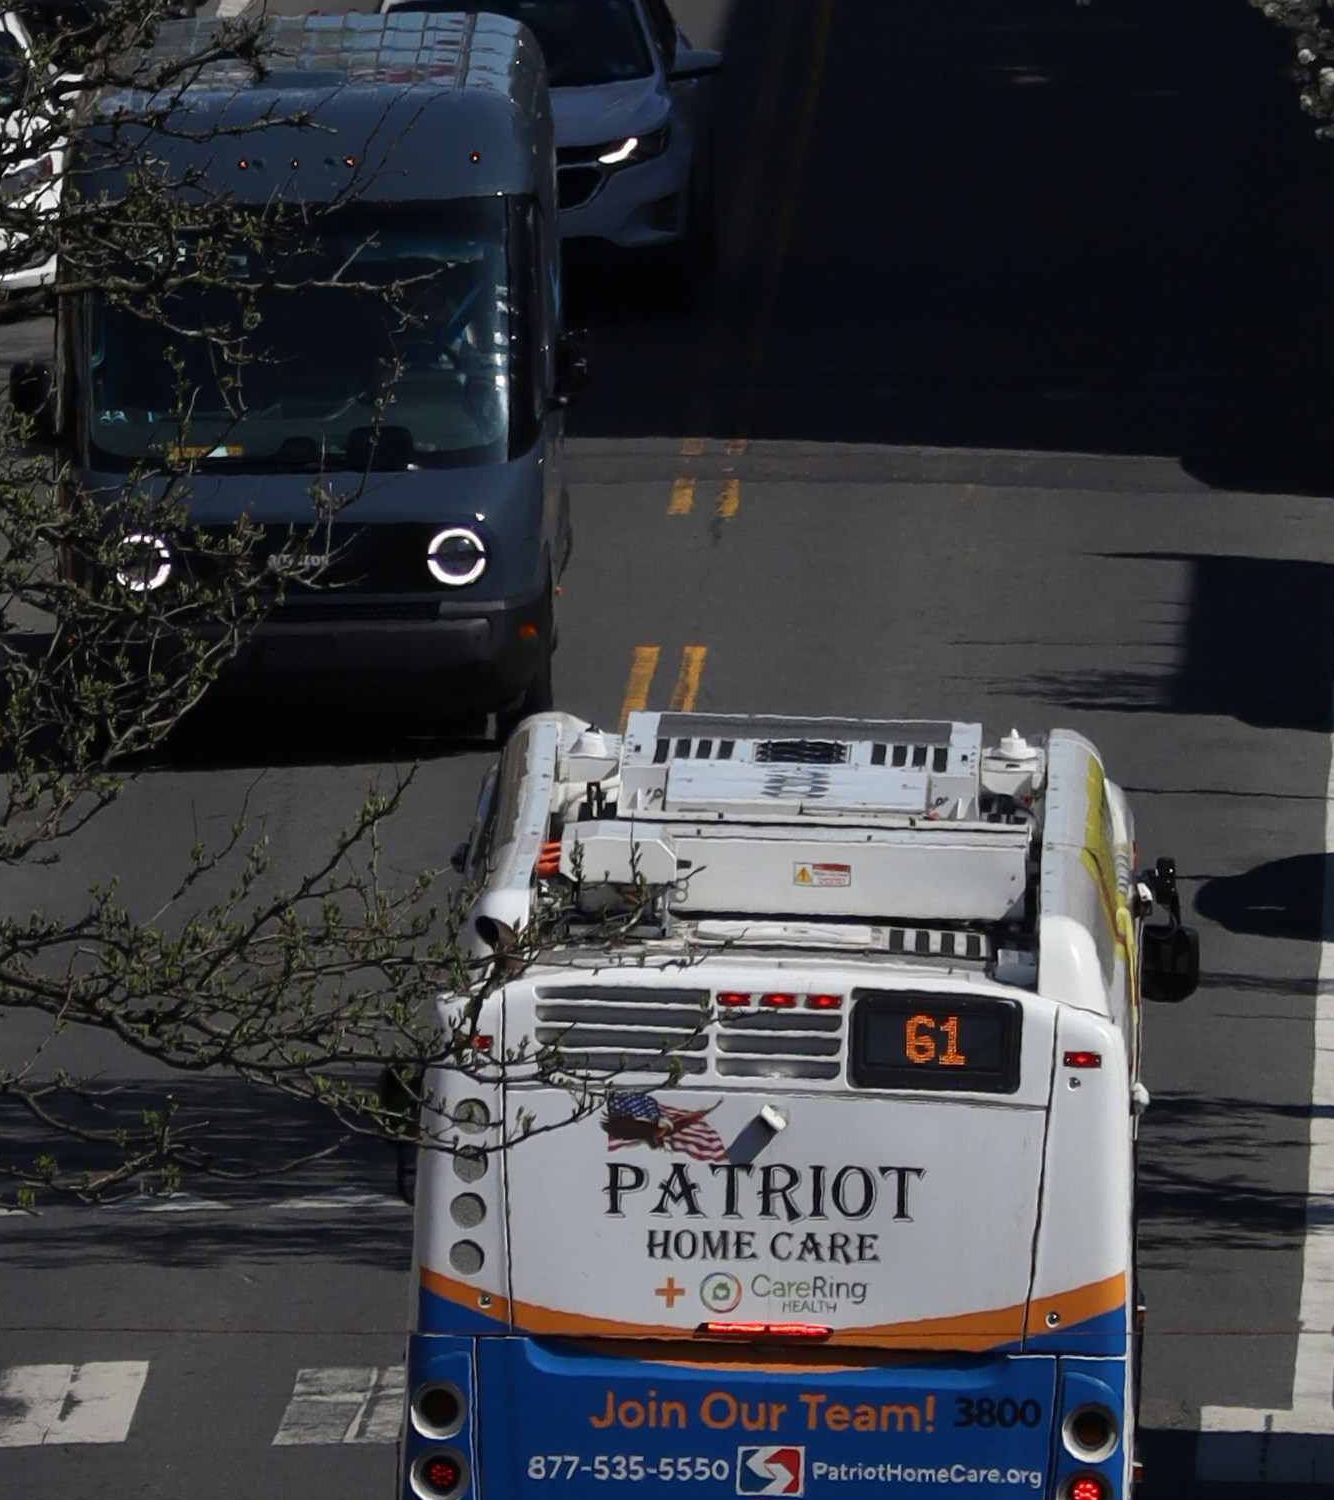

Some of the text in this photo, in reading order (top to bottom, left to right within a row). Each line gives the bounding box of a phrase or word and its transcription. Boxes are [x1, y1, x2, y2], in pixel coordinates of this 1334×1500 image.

[905, 1012, 966, 1067] 61
[602, 1162, 925, 1223] PATRIOT
[646, 1230, 882, 1264] HOME CARE
[750, 1274, 869, 1305] CareRing
[782, 1302, 837, 1314] HEALTH
[589, 1388, 936, 1434] Join Our Team!
[953, 1397, 1042, 1428] 3800
[527, 1454, 730, 1482] 877-535-5550
[812, 1461, 1042, 1489] PatriotHomeCare.org
